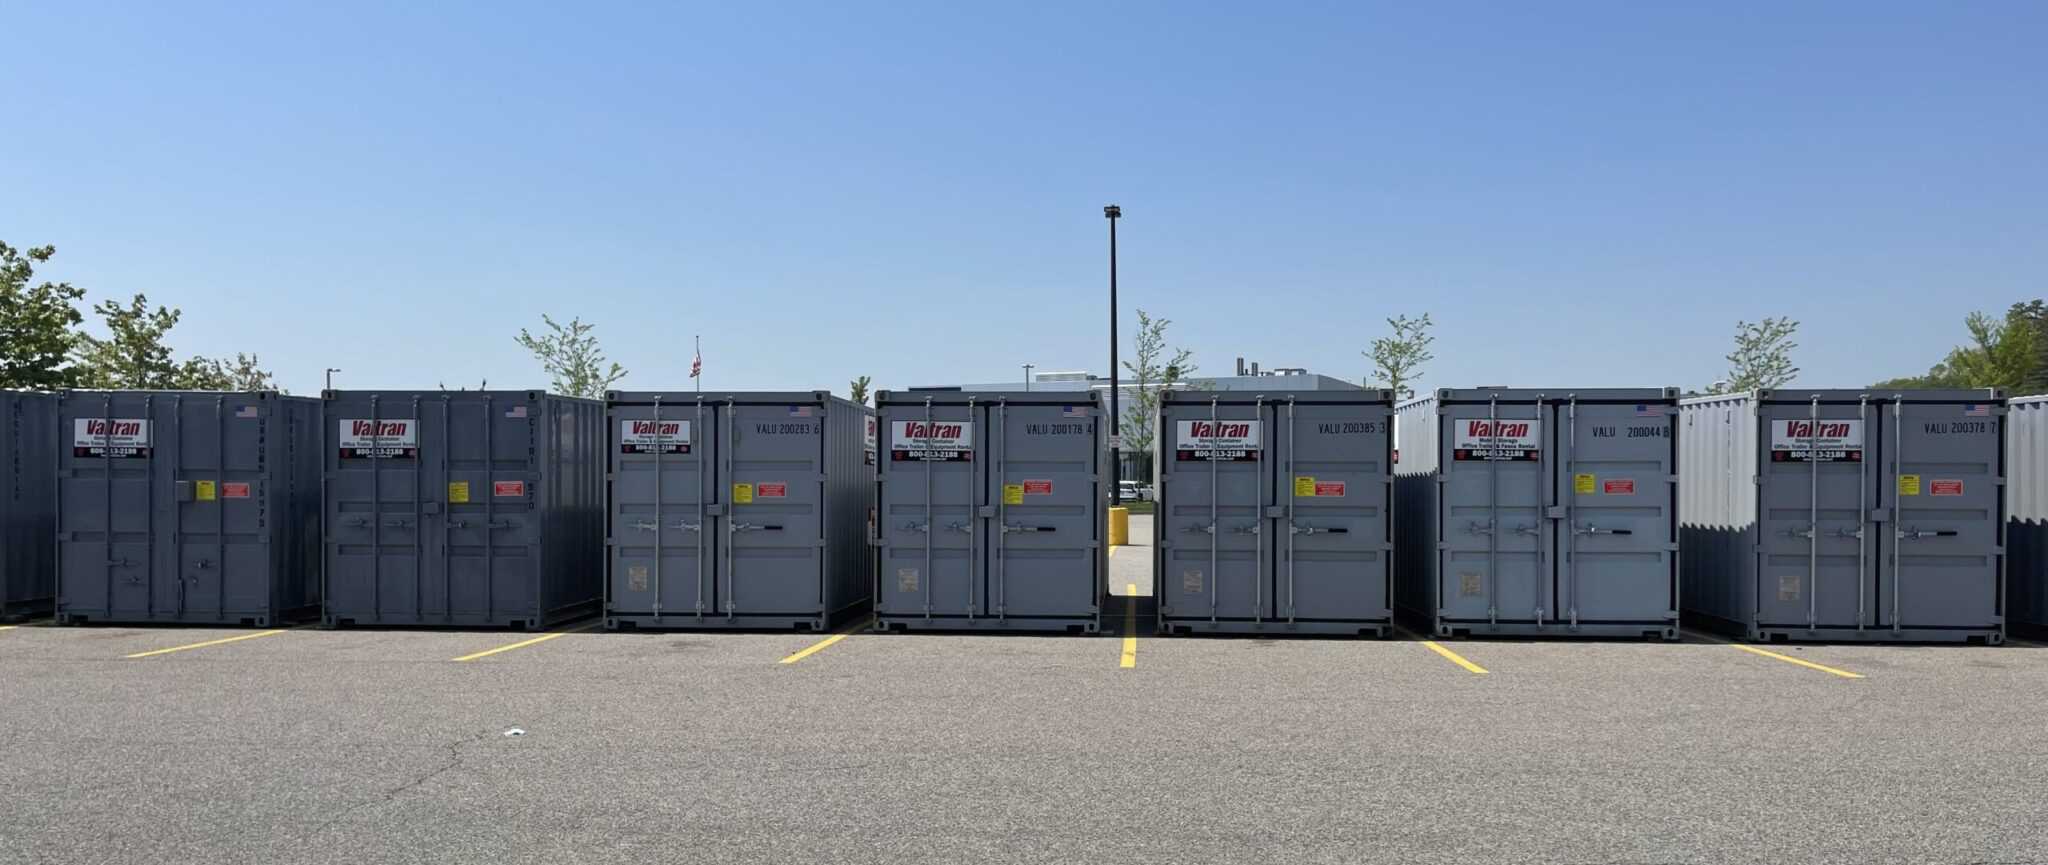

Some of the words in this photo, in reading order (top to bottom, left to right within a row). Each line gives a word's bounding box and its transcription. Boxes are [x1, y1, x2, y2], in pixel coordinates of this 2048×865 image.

[87, 419, 140, 435] Vatran
[756, 423, 777, 434] VALU
[1026, 423, 1048, 435] VALU
[1318, 423, 1340, 434] VALU
[1343, 422, 1375, 434] 200385
[1592, 426, 1616, 438] VALU
[1924, 423, 1948, 434] VALU
[1951, 422, 1985, 434] 200378
